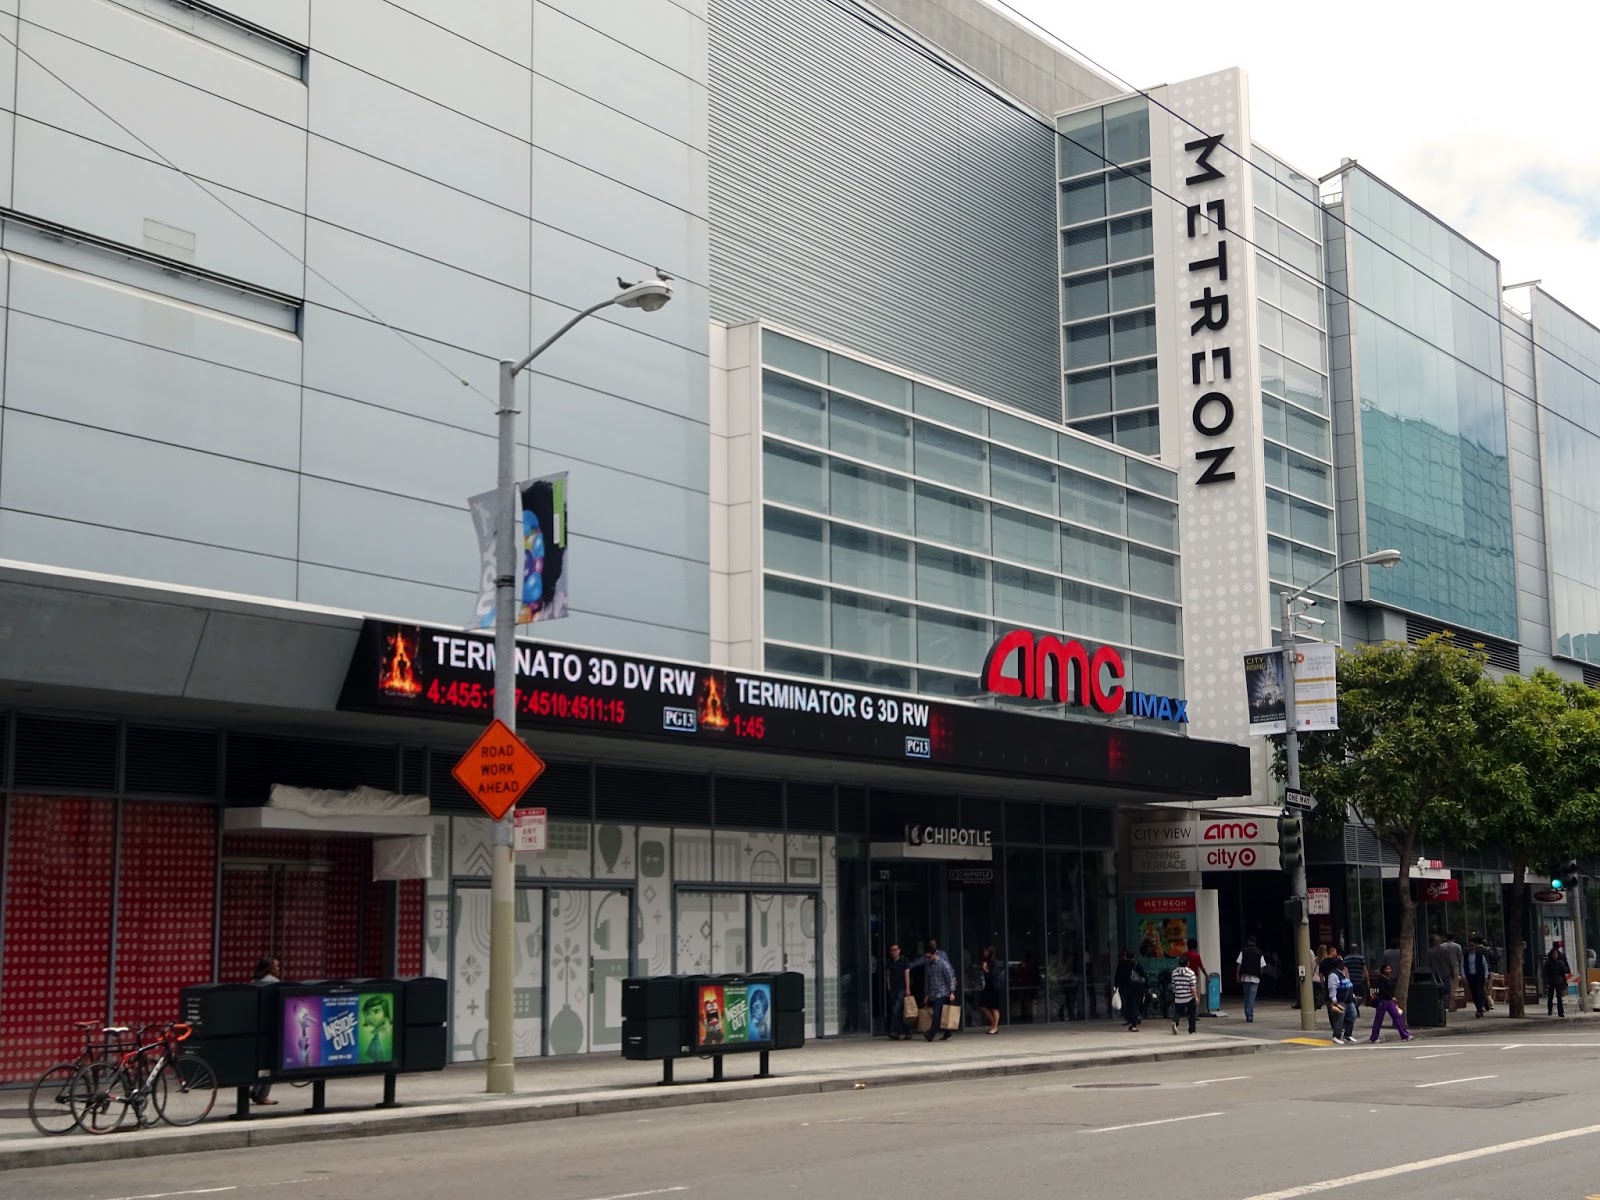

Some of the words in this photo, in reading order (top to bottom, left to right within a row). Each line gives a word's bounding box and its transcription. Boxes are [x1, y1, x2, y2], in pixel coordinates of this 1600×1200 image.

[1184, 133, 1236, 486] METREON
[432, 636, 582, 682] TERMNATO
[588, 657, 617, 686] 3D
[623, 662, 655, 692] DV
[660, 667, 695, 697] RW
[1246, 663, 1266, 671] RISING
[735, 677, 857, 719] TERMINATOR
[860, 696, 874, 721] G
[877, 699, 898, 723] 3D
[902, 702, 929, 728] RW
[1127, 690, 1190, 724] IMAX
[665, 710, 695, 728] PG13
[733, 714, 765, 740] 1:45
[481, 745, 515, 757] ROAD
[481, 763, 515, 776] WORK
[478, 781, 520, 794] AHEAD
[1288, 793, 1300, 803] ONE
[522, 836, 537, 844] TIME
[924, 826, 992, 847] CHIPOTLE
[1134, 828, 1159, 841] CITY
[1164, 827, 1192, 839] VIEW
[1207, 848, 1237, 868] city
[880, 869, 890, 879] 121
[322, 1012, 358, 1041] INSIDE
[732, 1012, 747, 1031] OUT
[333, 1027, 356, 1051] OUT
